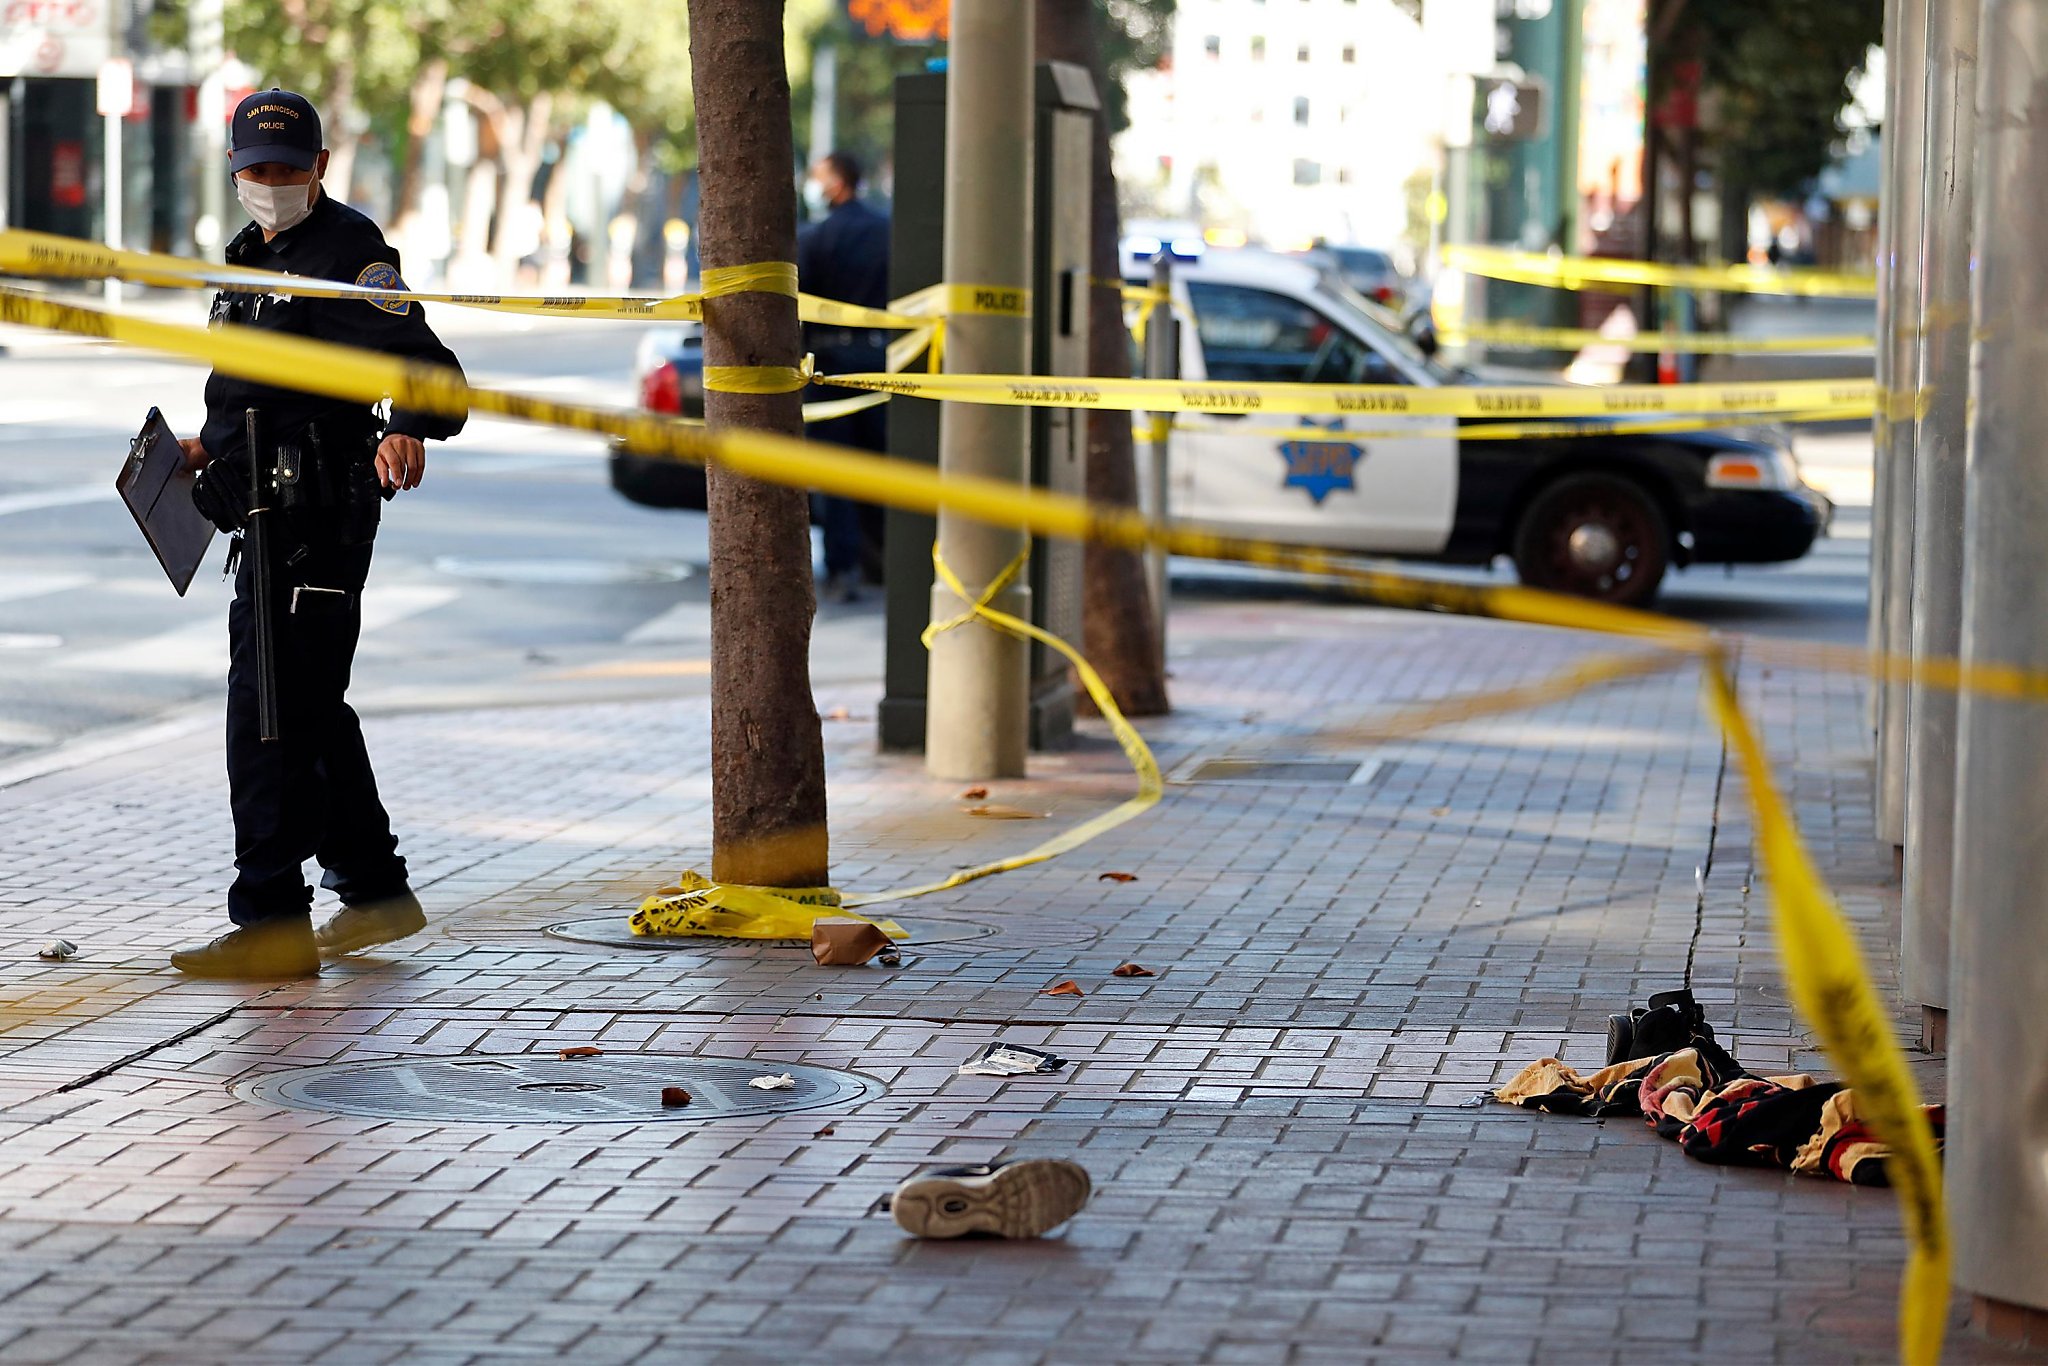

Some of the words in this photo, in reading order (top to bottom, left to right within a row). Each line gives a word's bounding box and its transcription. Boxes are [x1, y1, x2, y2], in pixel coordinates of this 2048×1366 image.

[246, 107, 260, 119] SAN
[260, 105, 300, 119] FRANCISCO
[258, 121, 286, 130] POLICE
